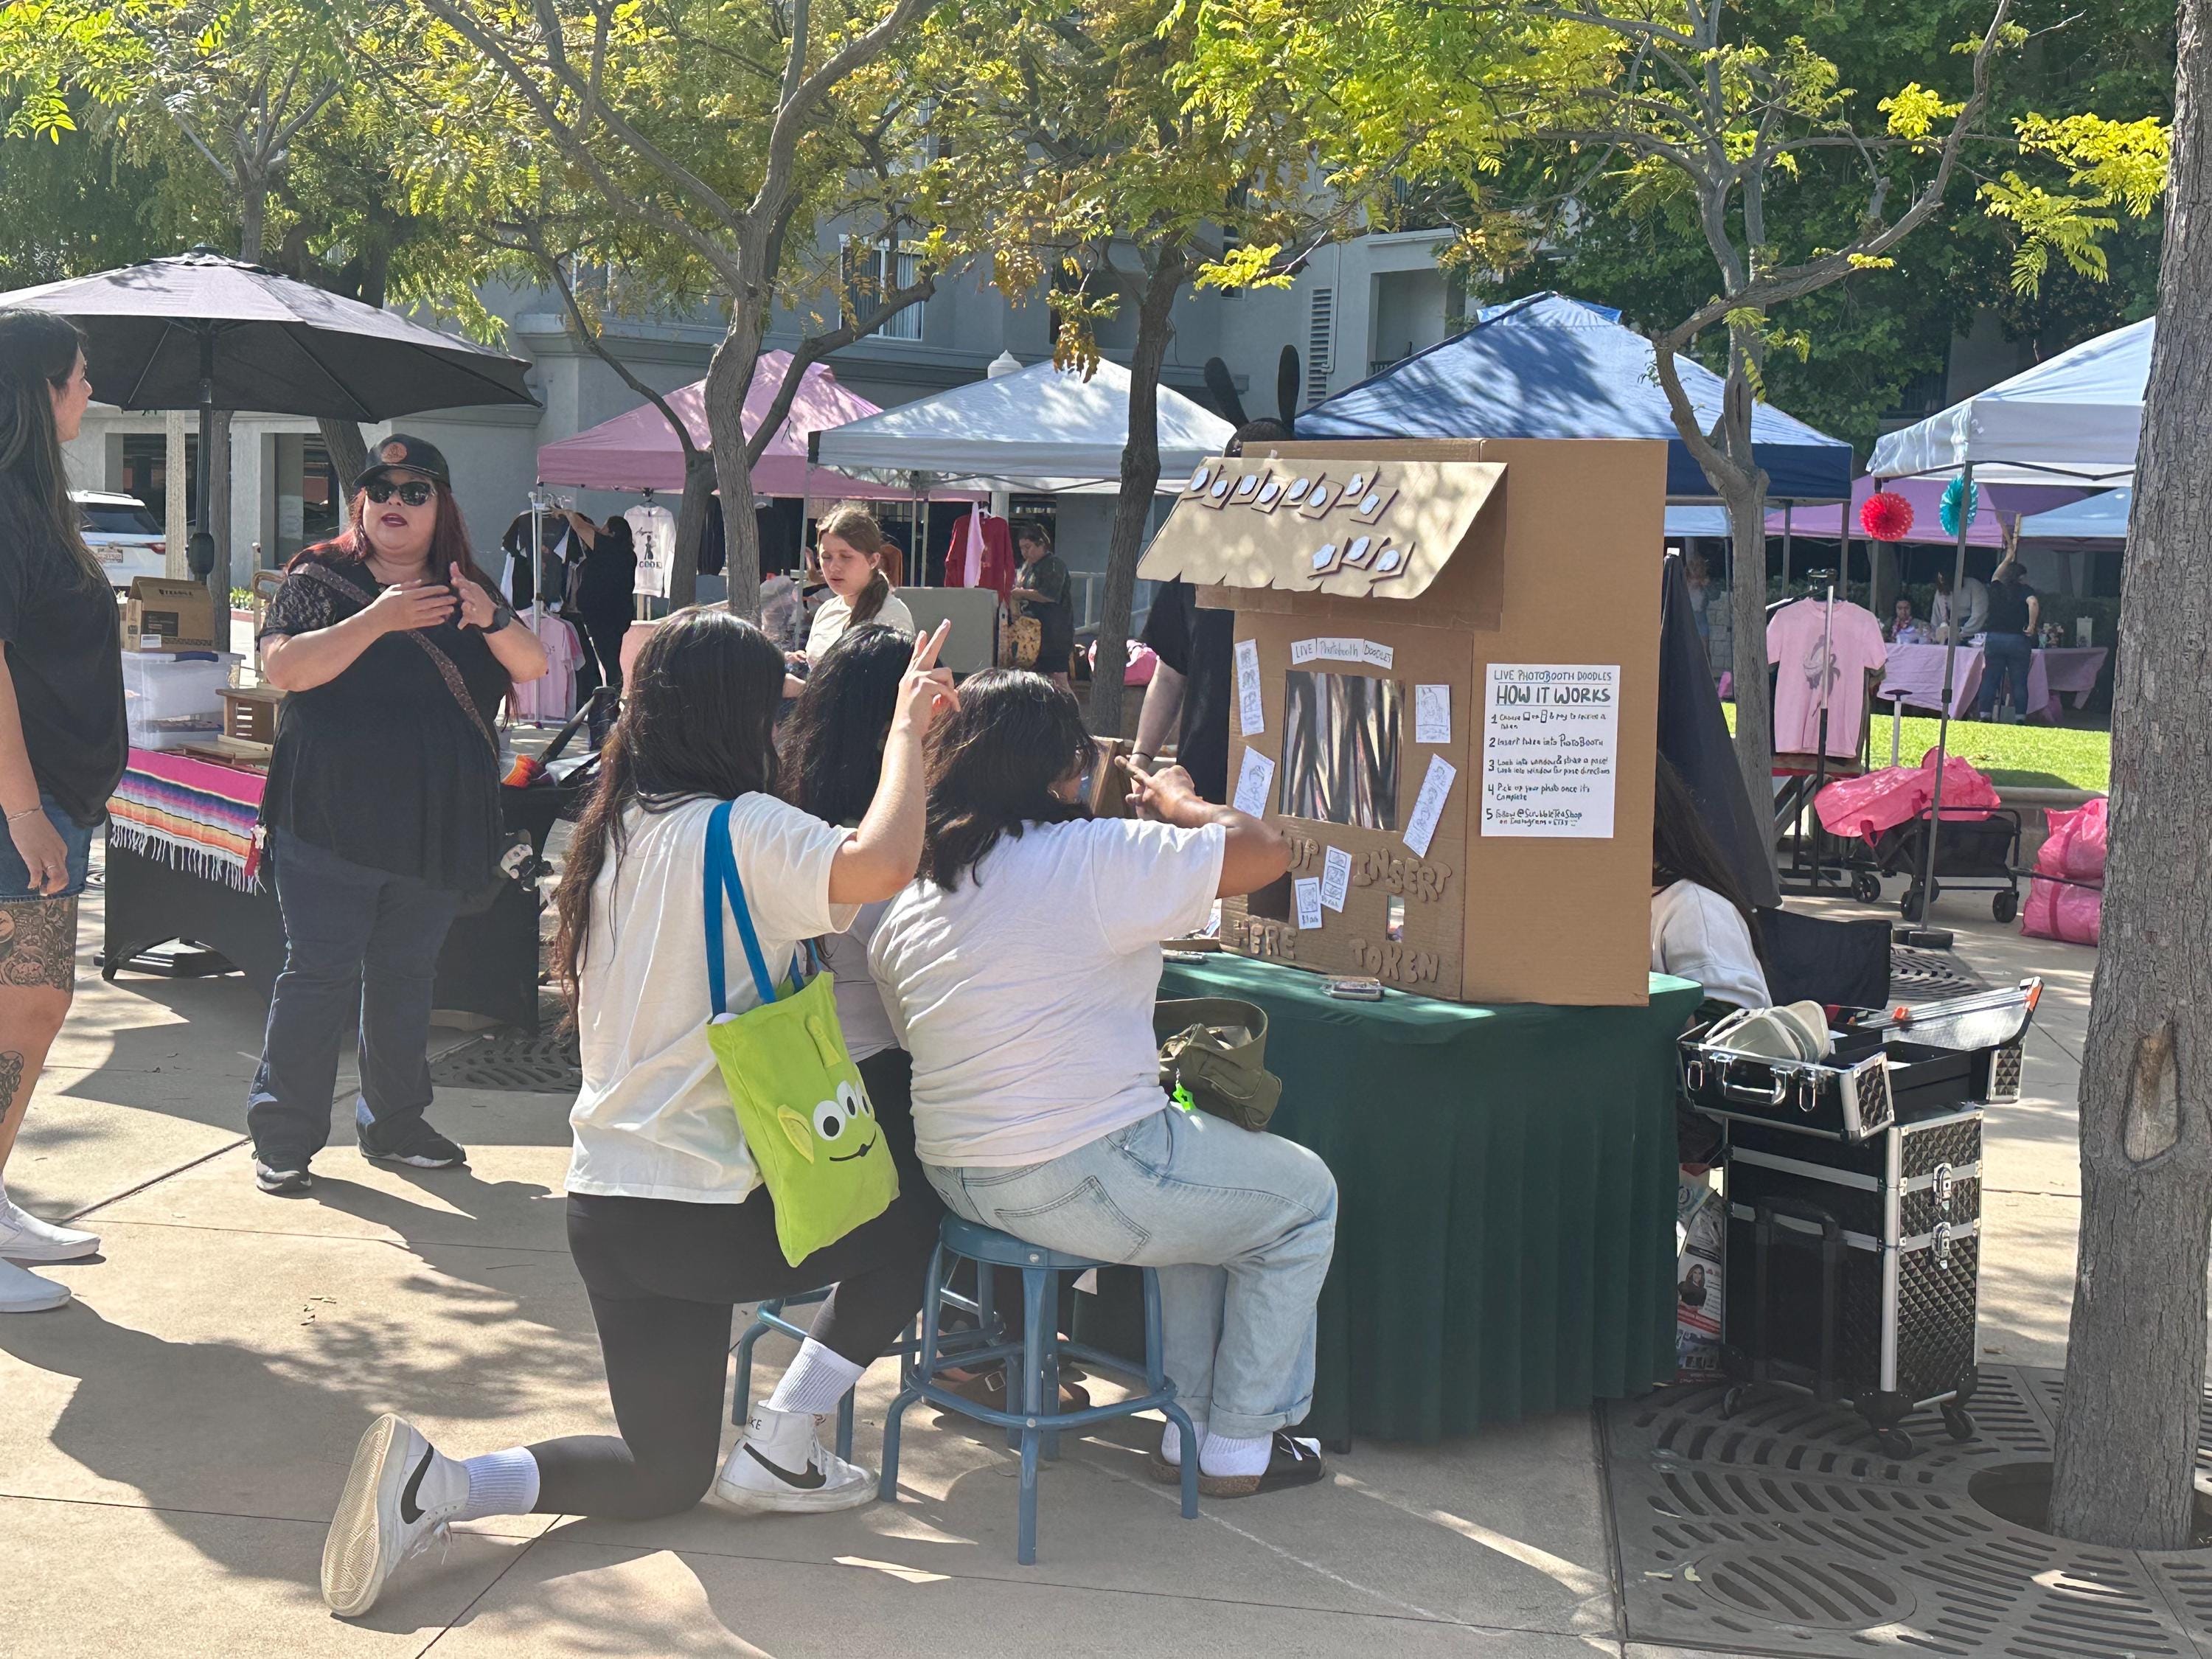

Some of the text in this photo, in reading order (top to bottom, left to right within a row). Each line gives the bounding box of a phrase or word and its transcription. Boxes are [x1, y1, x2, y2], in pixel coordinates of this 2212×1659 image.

[1295, 643, 1312, 658] LIVE
[1494, 669, 1514, 681] LIVE
[1577, 671, 1612, 681] DOODLES
[1496, 684, 1611, 705] HOW IT WORKS
[1491, 714, 1498, 724] 1
[1556, 713, 1568, 721] pay
[1489, 737, 1496, 748] 2
[1543, 736, 1557, 746] into
[1488, 759, 1495, 772] 3
[1487, 783, 1494, 796] 4
[1561, 785, 1578, 793] once
[1486, 807, 1493, 820] 5
[1352, 848, 1453, 903] INSERT
[1232, 919, 1298, 959] HERE
[1349, 936, 1440, 984] TOKEN
